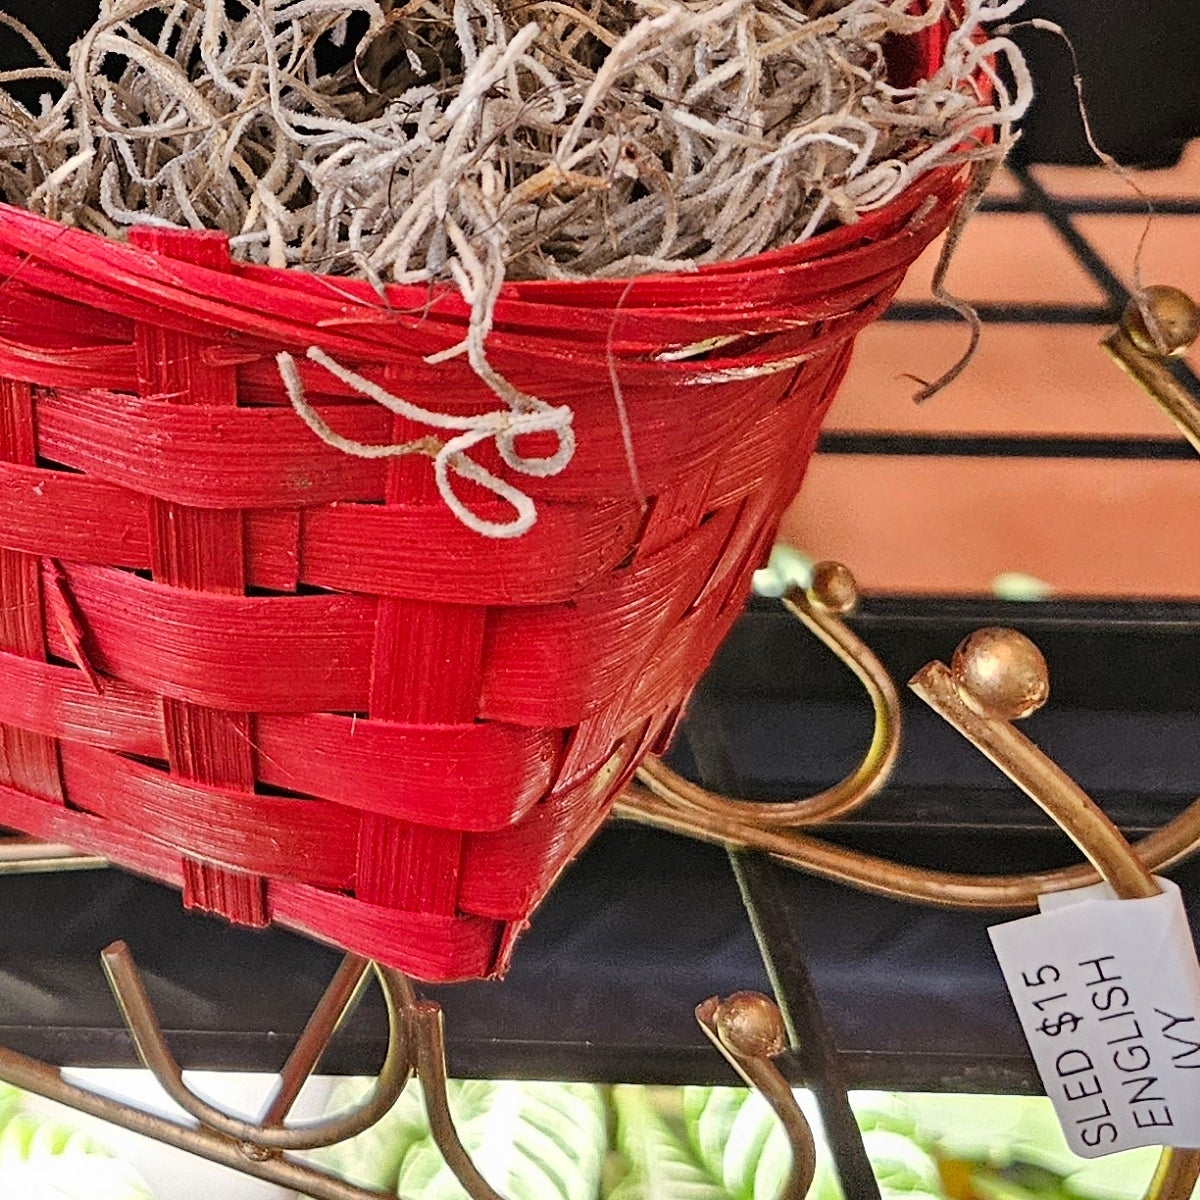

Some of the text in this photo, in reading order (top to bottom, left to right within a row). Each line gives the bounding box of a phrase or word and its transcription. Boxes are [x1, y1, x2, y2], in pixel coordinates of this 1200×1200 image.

[1021, 964, 1118, 1147] SLED $15
[1078, 955, 1174, 1128] ENGLISH
[1154, 1007, 1200, 1070] IVY
